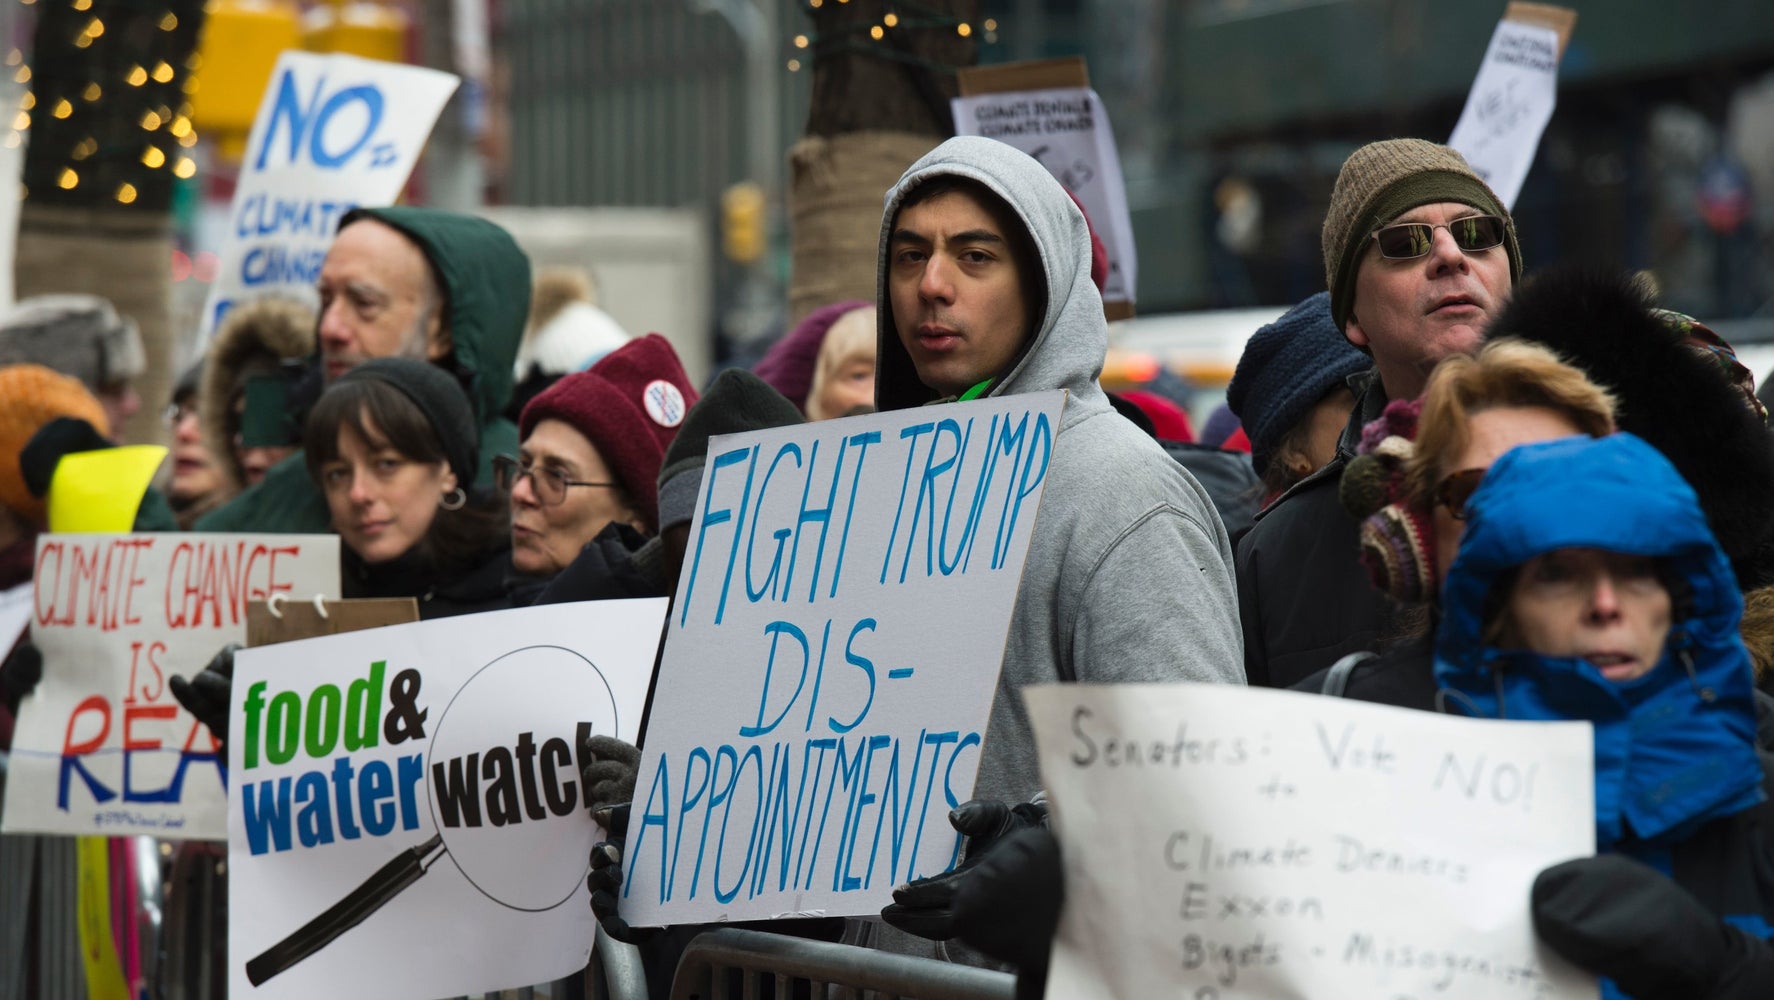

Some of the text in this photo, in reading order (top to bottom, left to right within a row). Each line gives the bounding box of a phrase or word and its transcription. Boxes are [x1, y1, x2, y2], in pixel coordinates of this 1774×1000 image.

[237, 193, 359, 238] CLIMAT
[680, 410, 1053, 629] FIGHT TRUMP
[33, 538, 301, 631] CLIMATE CHANGE
[123, 640, 167, 703] IS
[57, 694, 228, 812] REA
[1257, 773, 1298, 799] to
[1313, 719, 1398, 776] Vote
[1431, 750, 1542, 815] NO!
[241, 751, 424, 857] water
[623, 725, 981, 906] APPOINTMENTS
[1162, 829, 1470, 884] Climate Deniers
[1177, 880, 1325, 922] Exxon
[1181, 931, 1282, 989] Bigots
